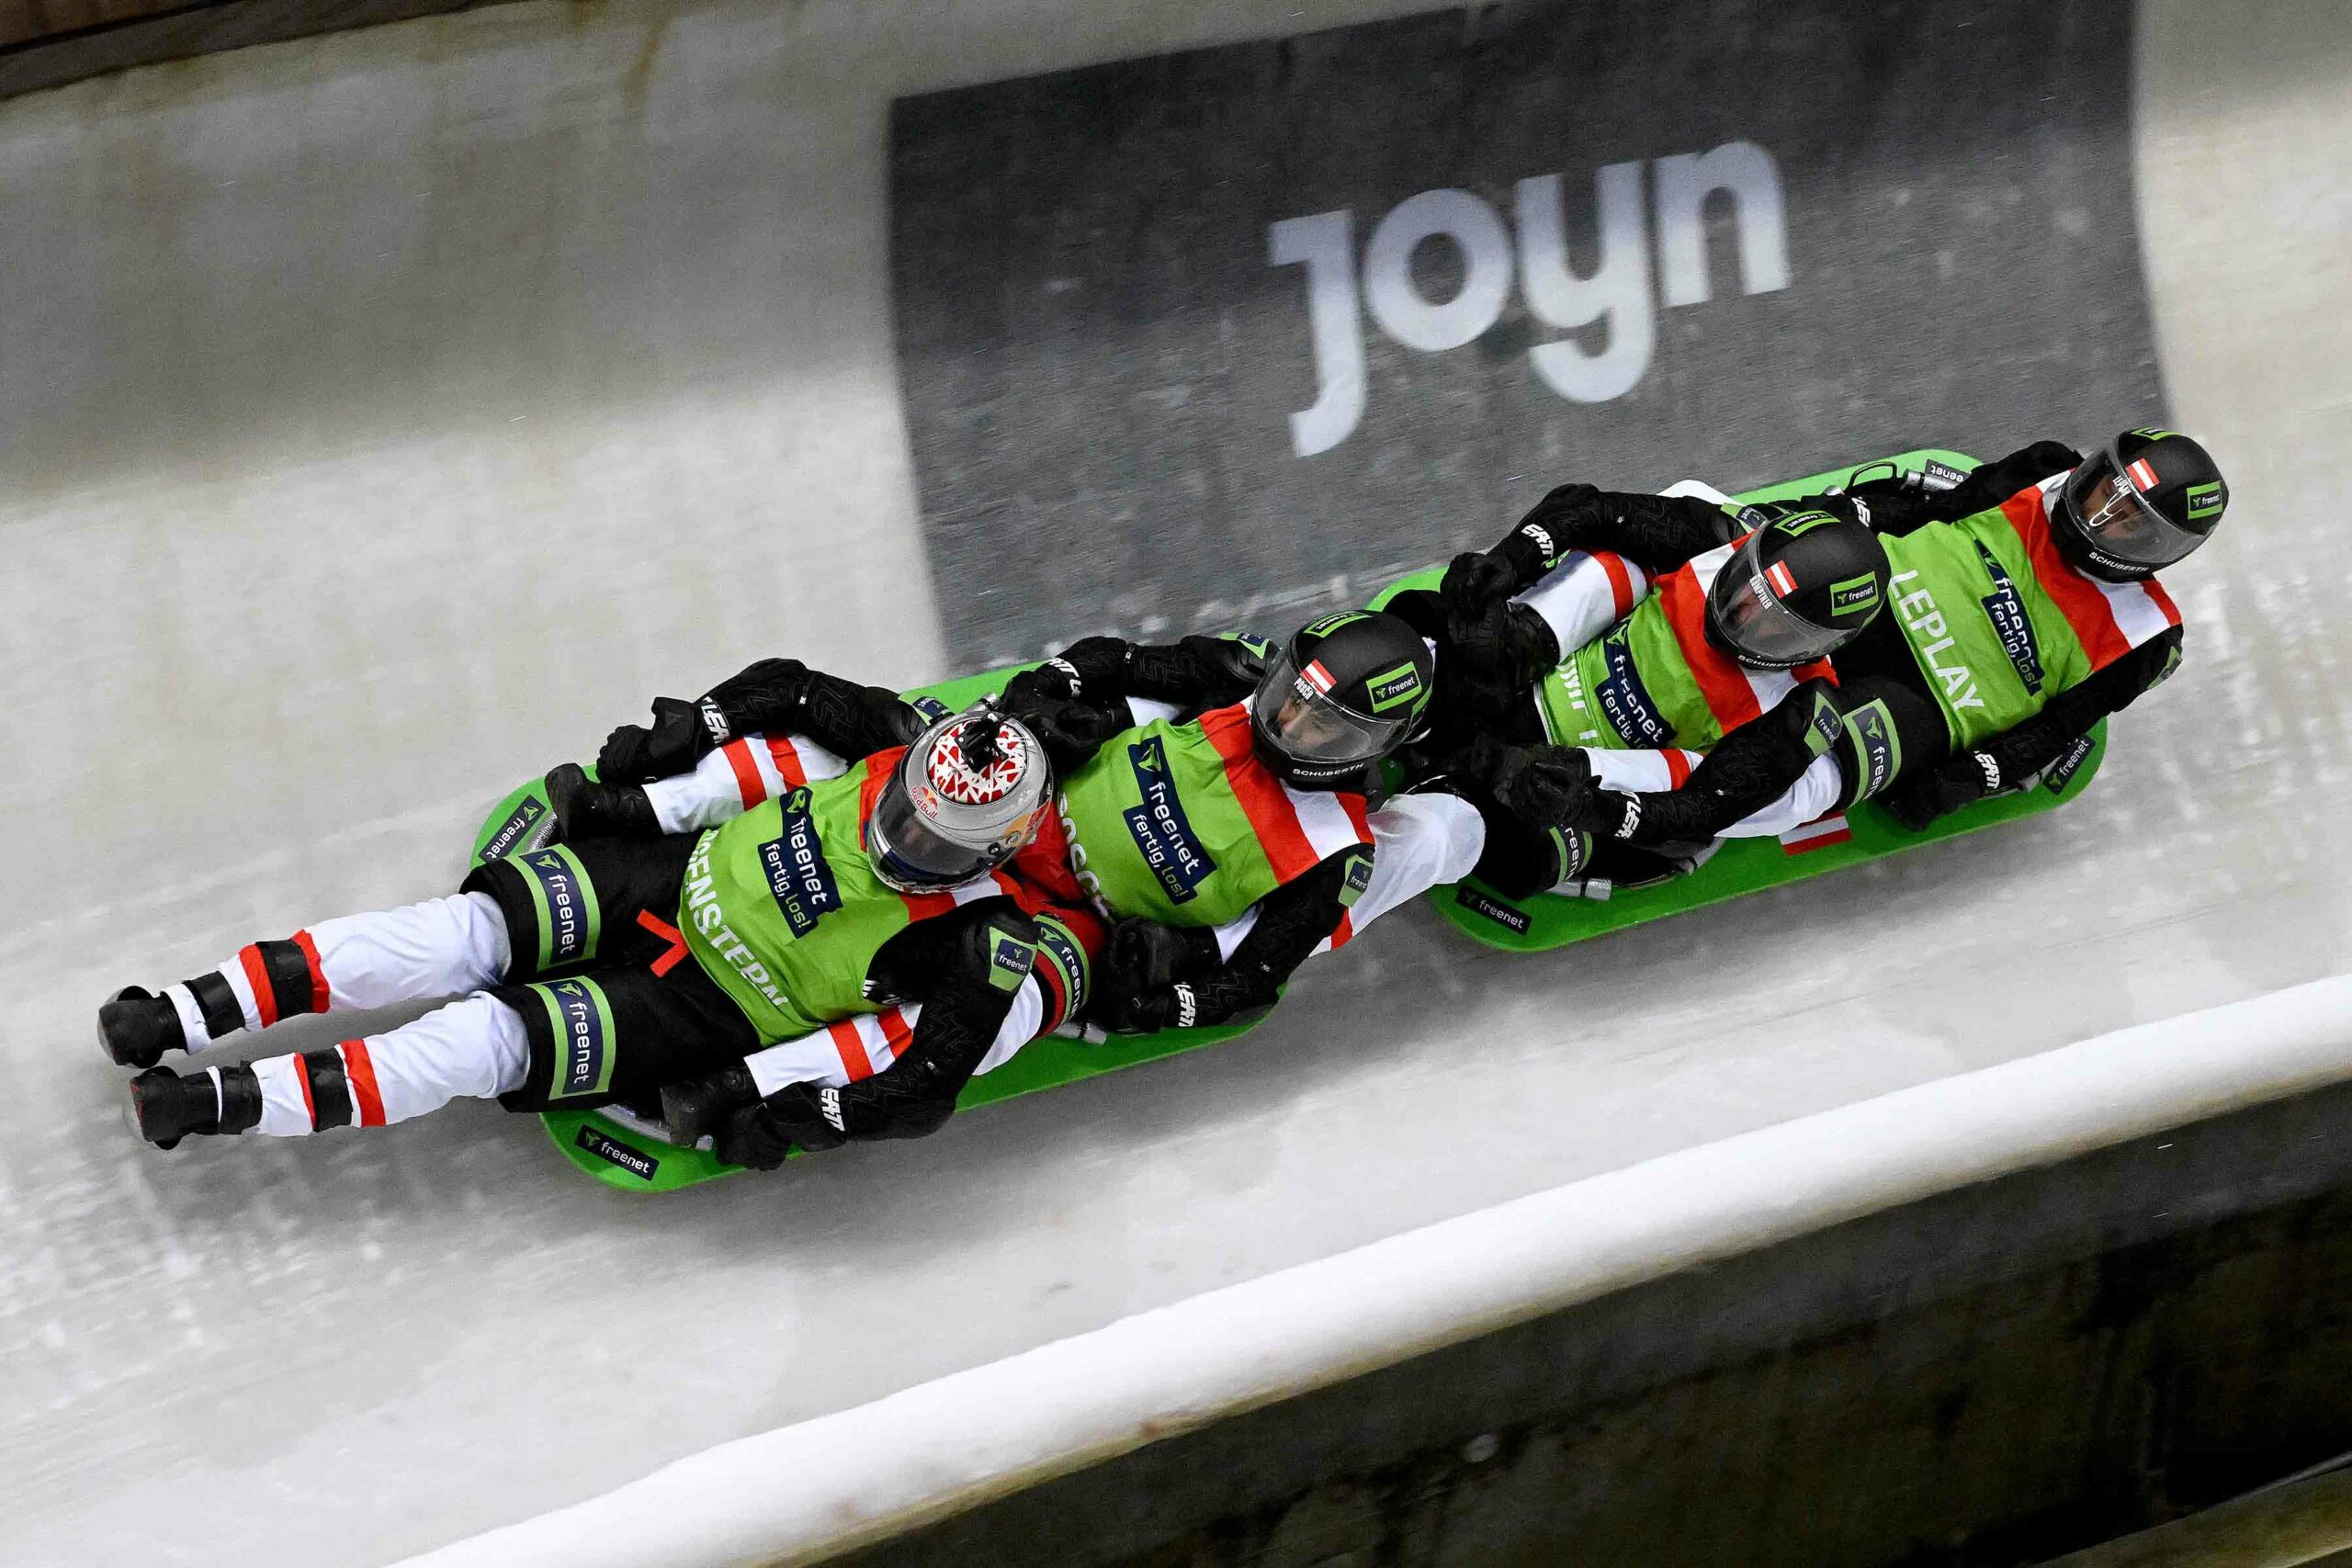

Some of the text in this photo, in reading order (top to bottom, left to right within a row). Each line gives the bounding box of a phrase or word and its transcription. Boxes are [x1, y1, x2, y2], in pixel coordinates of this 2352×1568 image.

[1269, 141, 1792, 457] joyn
[1930, 465, 1964, 482] eenet
[2088, 551, 2149, 571] SCHUBERTH
[1849, 586, 1873, 602] freenet
[1889, 570, 1984, 711] LEPLAY
[1991, 603, 2019, 658] fertig,
[1388, 676, 1415, 695] freenet
[1602, 688, 1633, 740] fertig,
[1293, 762, 1364, 776] SCHUBERTH
[2059, 739, 2089, 776] freenet
[921, 803, 938, 819] Bull
[1149, 781, 1200, 875] freenet
[486, 818, 526, 859] freenet
[1133, 814, 1189, 897] fertig, los!
[791, 817, 827, 905] freenet
[765, 843, 812, 929] fertig, los!
[548, 874, 576, 954] freenet
[1479, 899, 1523, 929] freenet
[999, 954, 1027, 972] freenet
[569, 1001, 591, 1084] freenet
[601, 1142, 650, 1174] freenet
